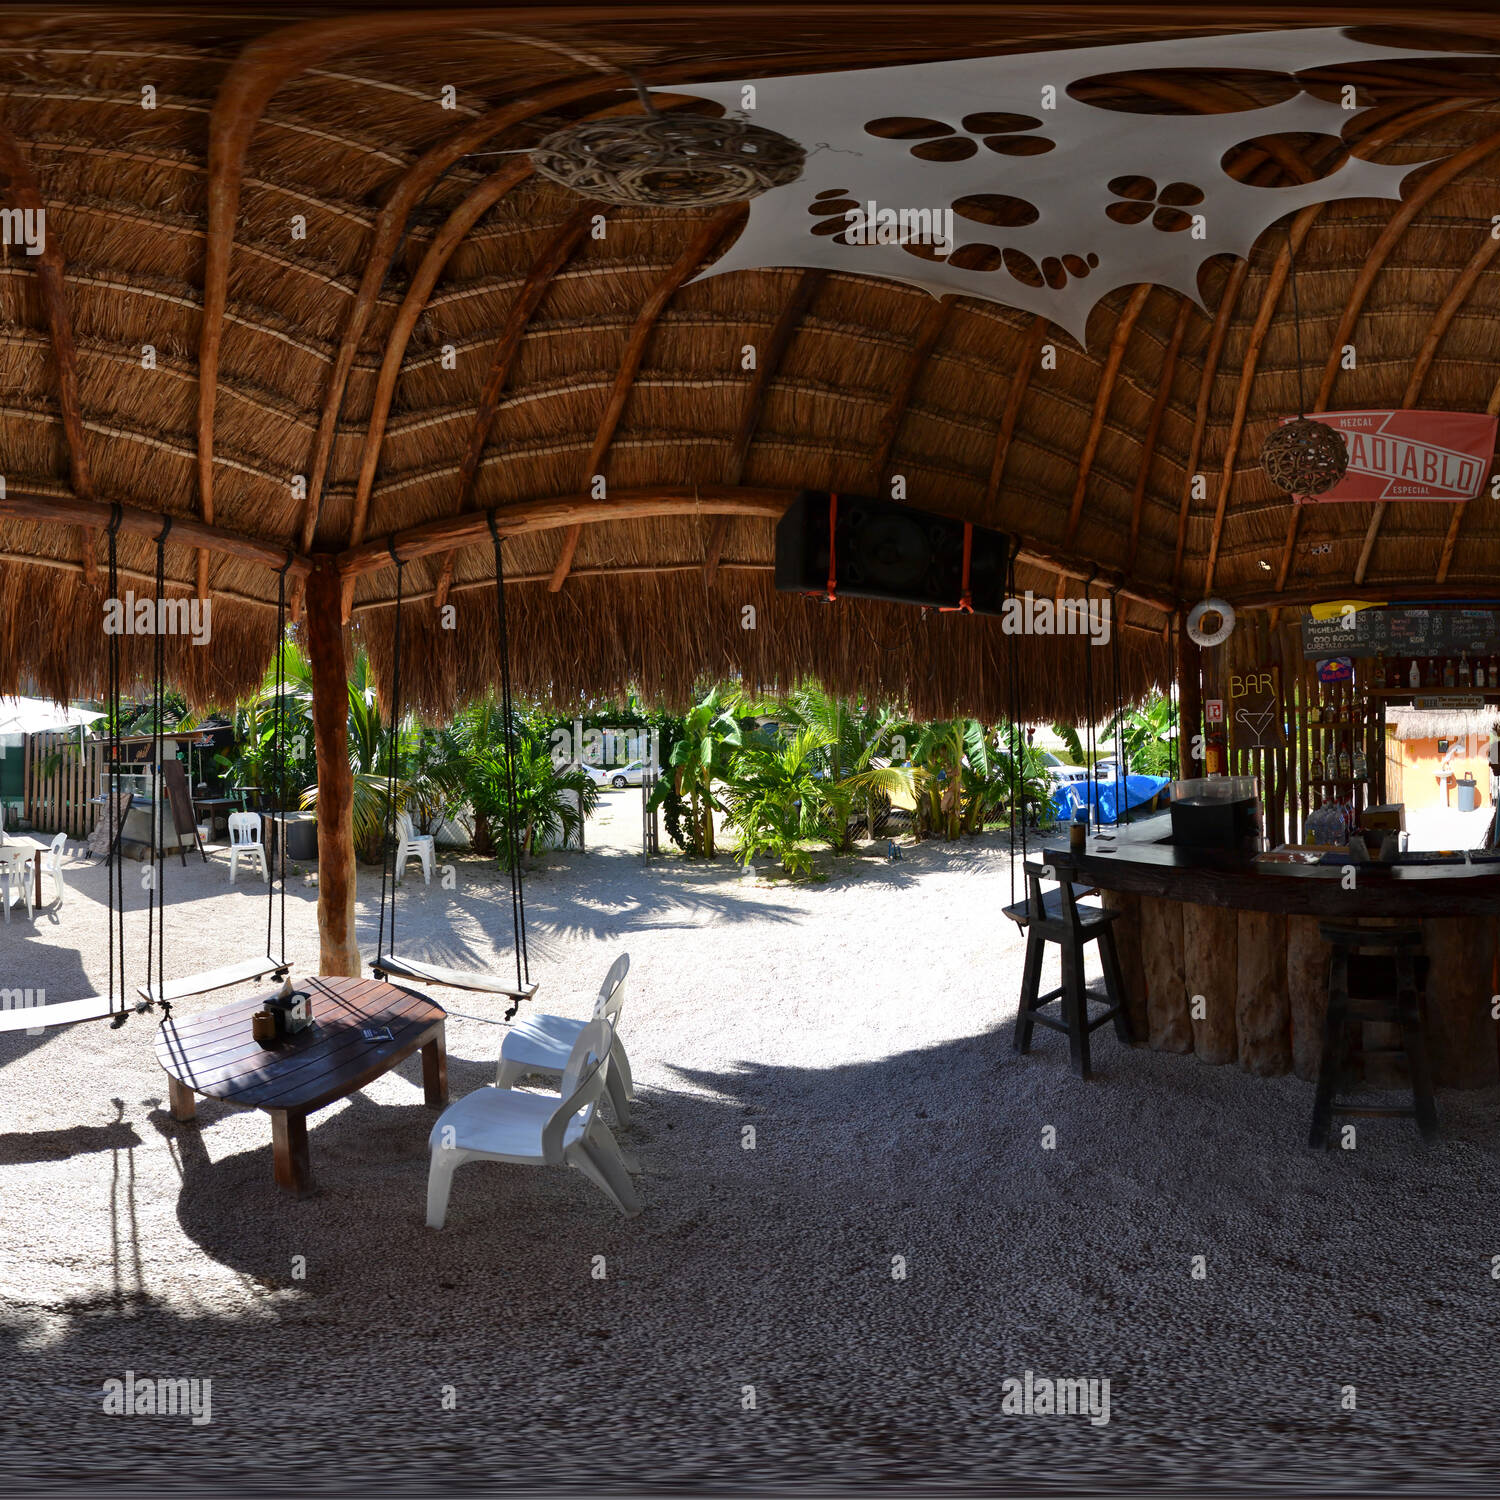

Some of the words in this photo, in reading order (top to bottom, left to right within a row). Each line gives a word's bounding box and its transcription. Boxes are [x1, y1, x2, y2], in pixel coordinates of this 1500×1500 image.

[1340, 418, 1373, 427] MEZCAL
[1344, 432, 1474, 490] ADIABLO
[1393, 486, 1430, 495] ESPECIAL
[1230, 673, 1276, 698] BAR
